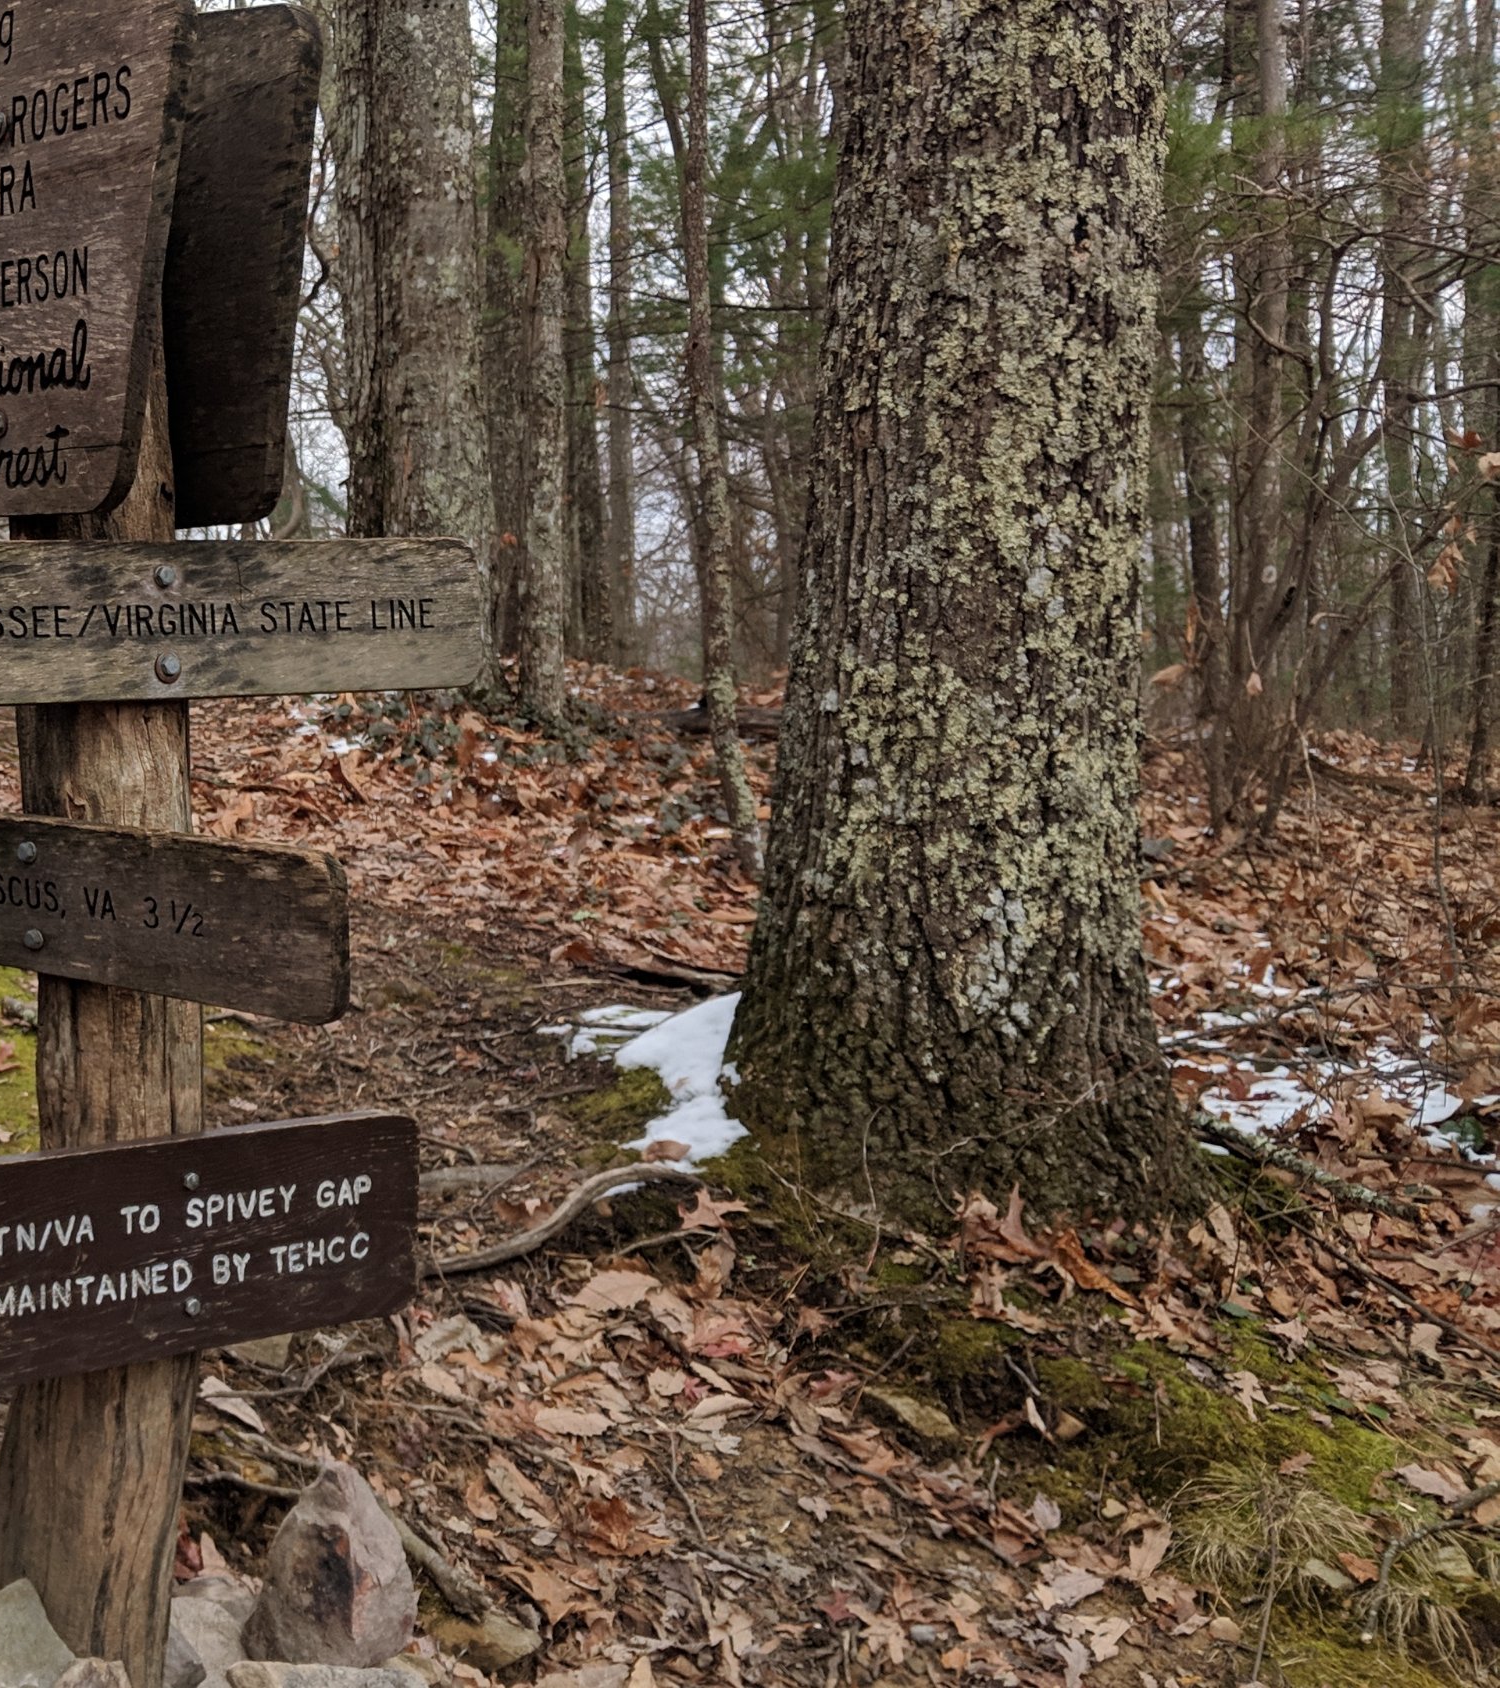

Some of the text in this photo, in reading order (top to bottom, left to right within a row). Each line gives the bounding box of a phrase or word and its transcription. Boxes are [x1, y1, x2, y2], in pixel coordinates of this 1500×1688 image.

[10, 65, 132, 147] ROGERS
[260, 601, 352, 633] STATE
[371, 598, 436, 630] LINE
[83, 887, 116, 920] VA
[143, 896, 159, 929] 3
[120, 1203, 160, 1236] TO
[185, 1183, 297, 1230] SPIVEY
[316, 1174, 372, 1209] GAP
[212, 1252, 252, 1286] BY
[270, 1232, 370, 1275] TEHCC
